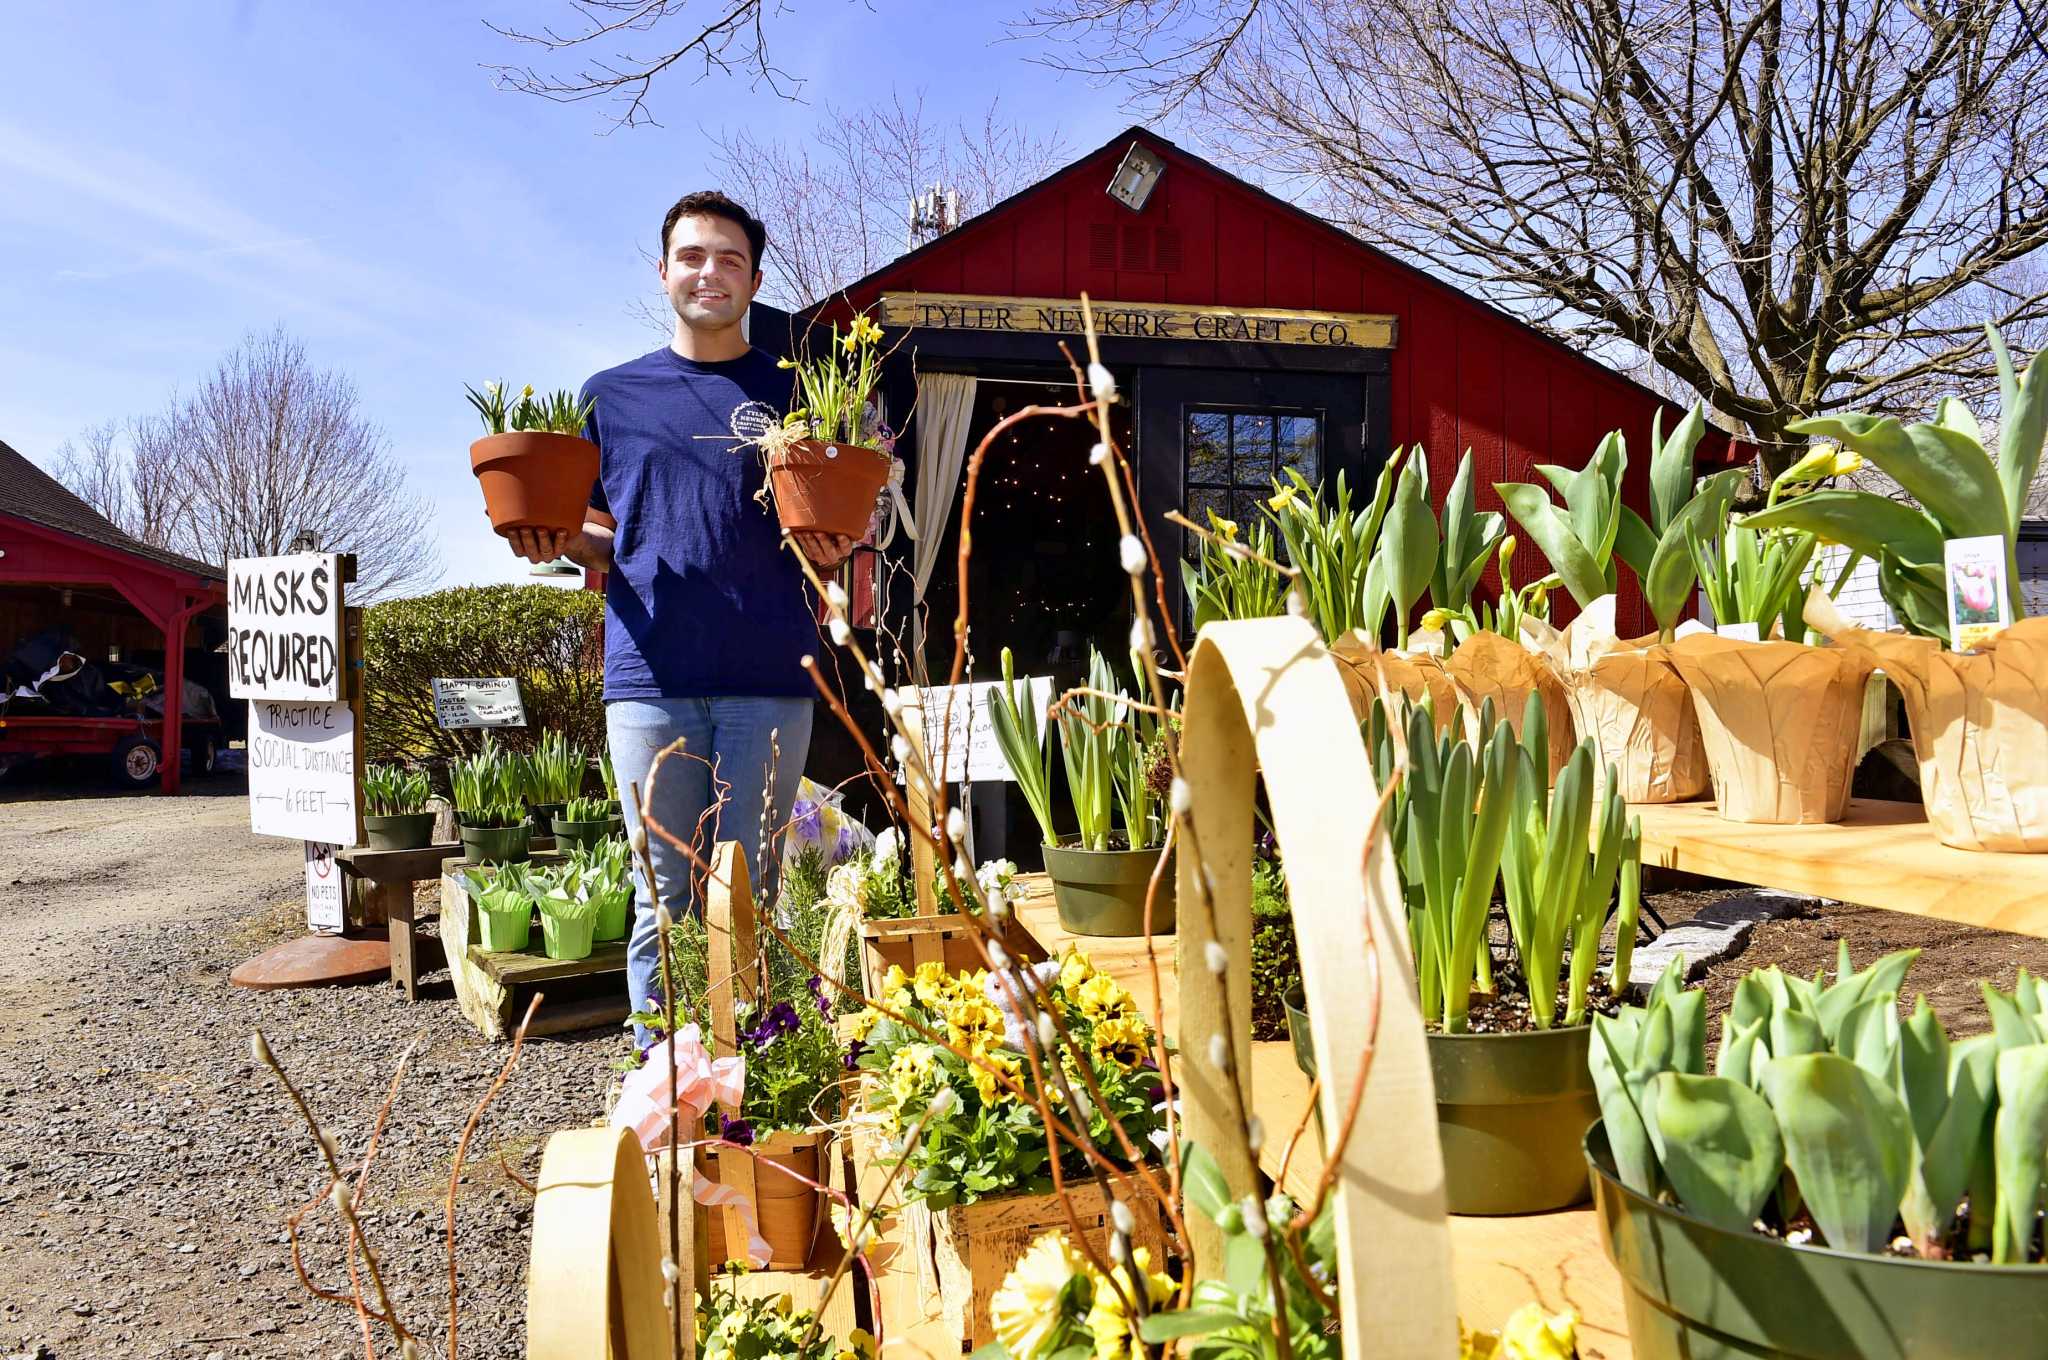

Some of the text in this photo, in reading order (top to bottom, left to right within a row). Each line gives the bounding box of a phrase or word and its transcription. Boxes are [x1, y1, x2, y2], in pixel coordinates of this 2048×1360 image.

[919, 305, 1014, 330] TYLER
[1194, 315, 1287, 342] CRAFT
[1310, 321, 1354, 346] CO.
[234, 567, 329, 617] MASKS
[229, 627, 336, 691] REQUIRED
[440, 680, 471, 691] HAPPY
[266, 704, 335, 729] PRACTICE
[253, 736, 352, 775] SOCIAL DISTANCE
[286, 787, 326, 815] 6 FEET
[311, 885, 337, 901] NO PETS
